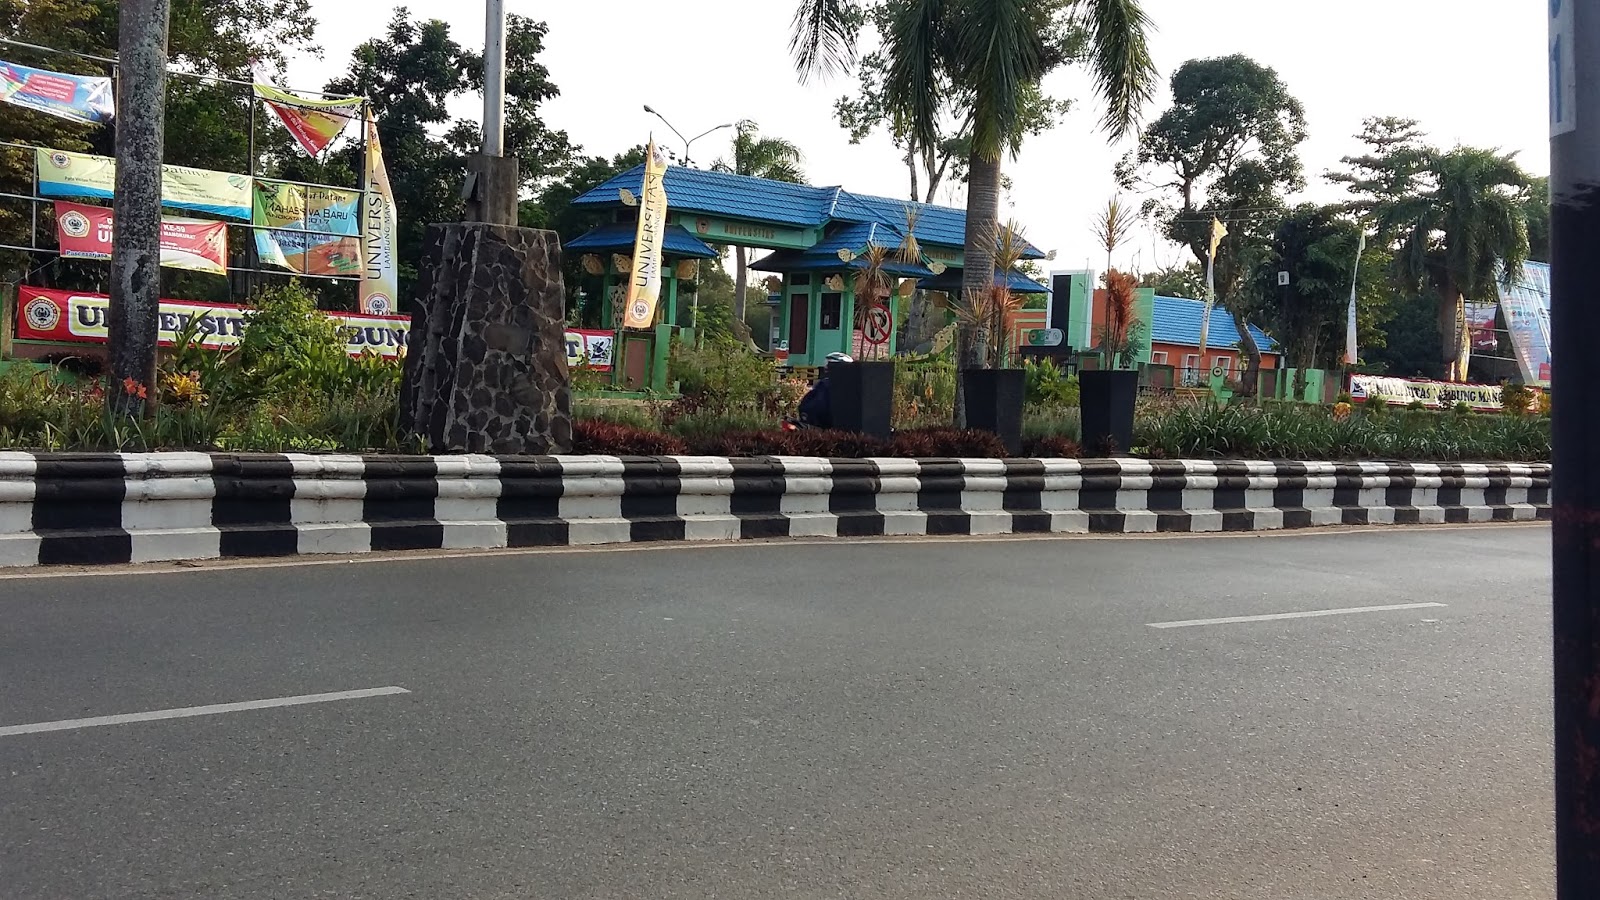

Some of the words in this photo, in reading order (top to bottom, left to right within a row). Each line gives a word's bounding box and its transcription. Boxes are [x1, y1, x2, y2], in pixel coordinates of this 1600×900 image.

[163, 224, 186, 233] KE-59
[266, 203, 321, 219] MAHASSWA
[323, 208, 349, 221] BARU
[367, 175, 383, 280] UNIVERSIT
[635, 174, 658, 288] UNIVERSITAS
